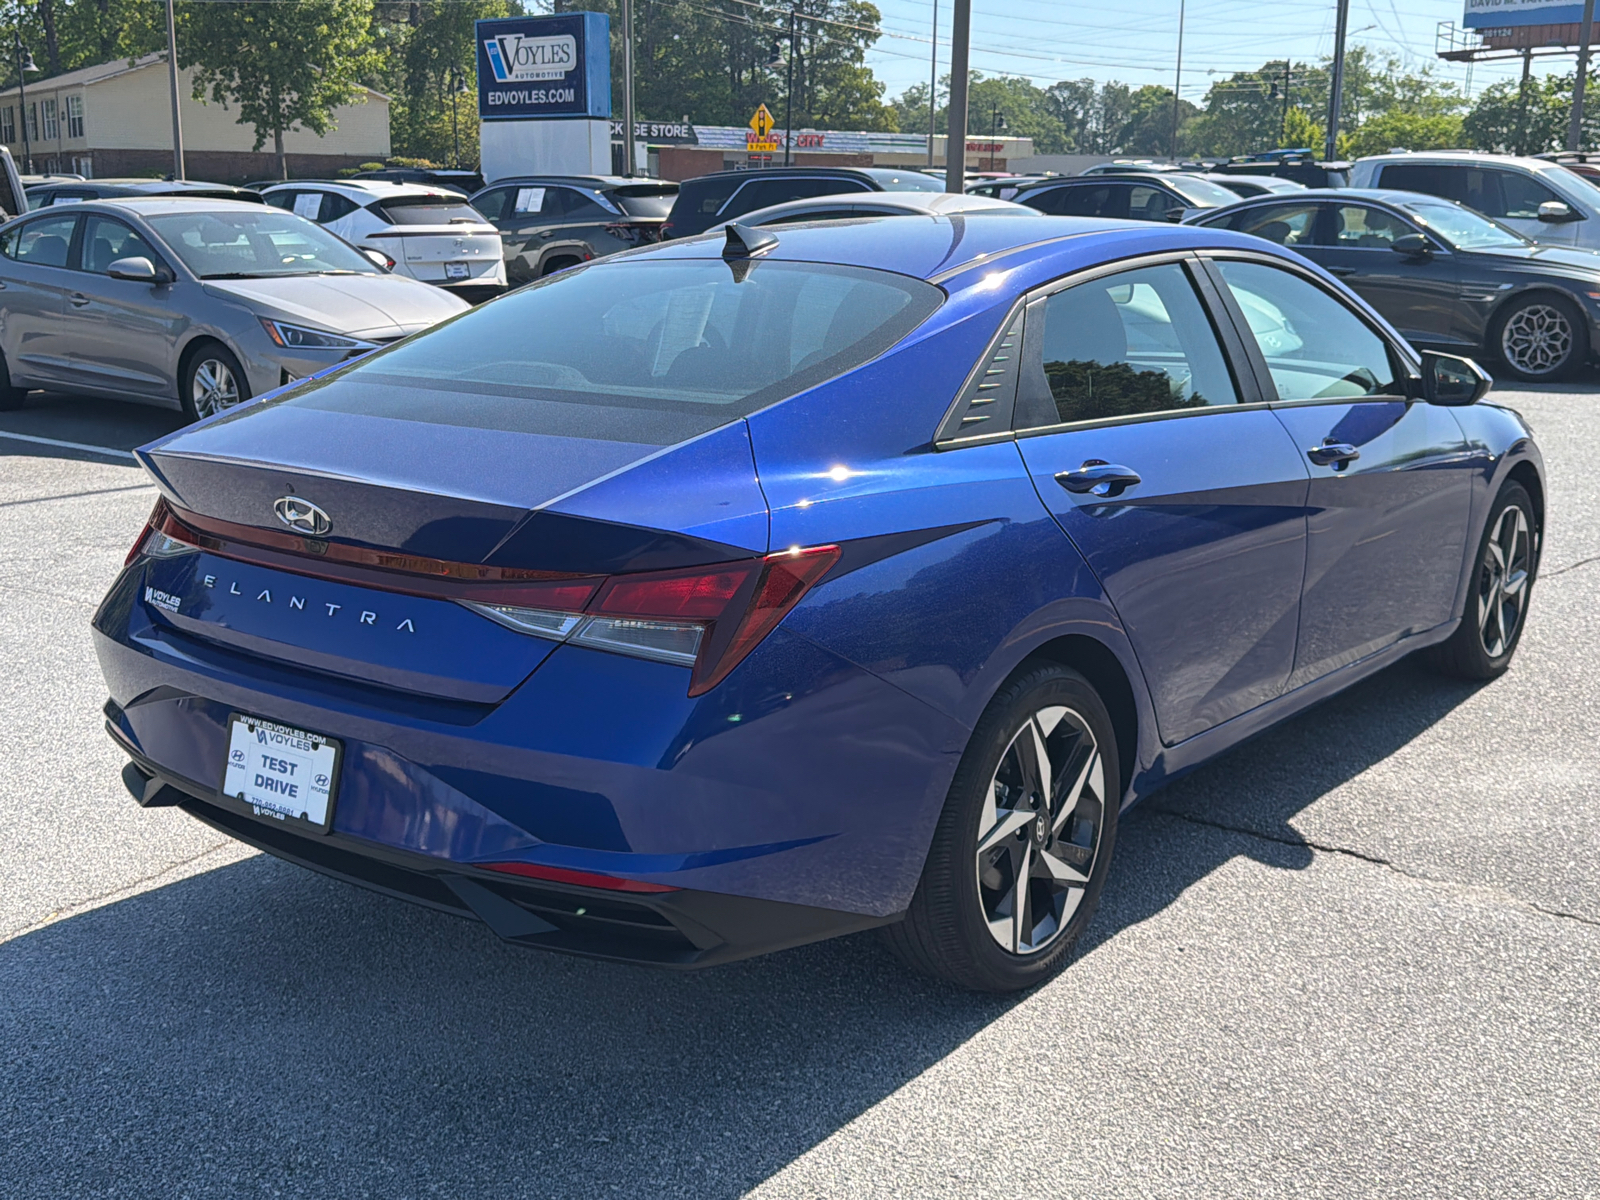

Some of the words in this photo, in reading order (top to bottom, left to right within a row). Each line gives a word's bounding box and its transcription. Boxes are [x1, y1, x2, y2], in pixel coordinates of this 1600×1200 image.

[497, 36, 571, 76] VOYLES
[488, 88, 575, 105] EDVOYLES.COM
[650, 124, 689, 137] STORE
[798, 134, 825, 147] CITY
[152, 599, 179, 613] AUTOMOTIVE
[153, 589, 181, 607] VOYLES
[203, 574, 415, 633] ELANTRA
[240, 714, 327, 745] WWW.EDVOYLES.COM
[269, 731, 311, 752] VOYLES
[261, 754, 298, 777] TEST
[254, 773, 299, 799] DRIVE
[261, 807, 286, 821] VOYLES
